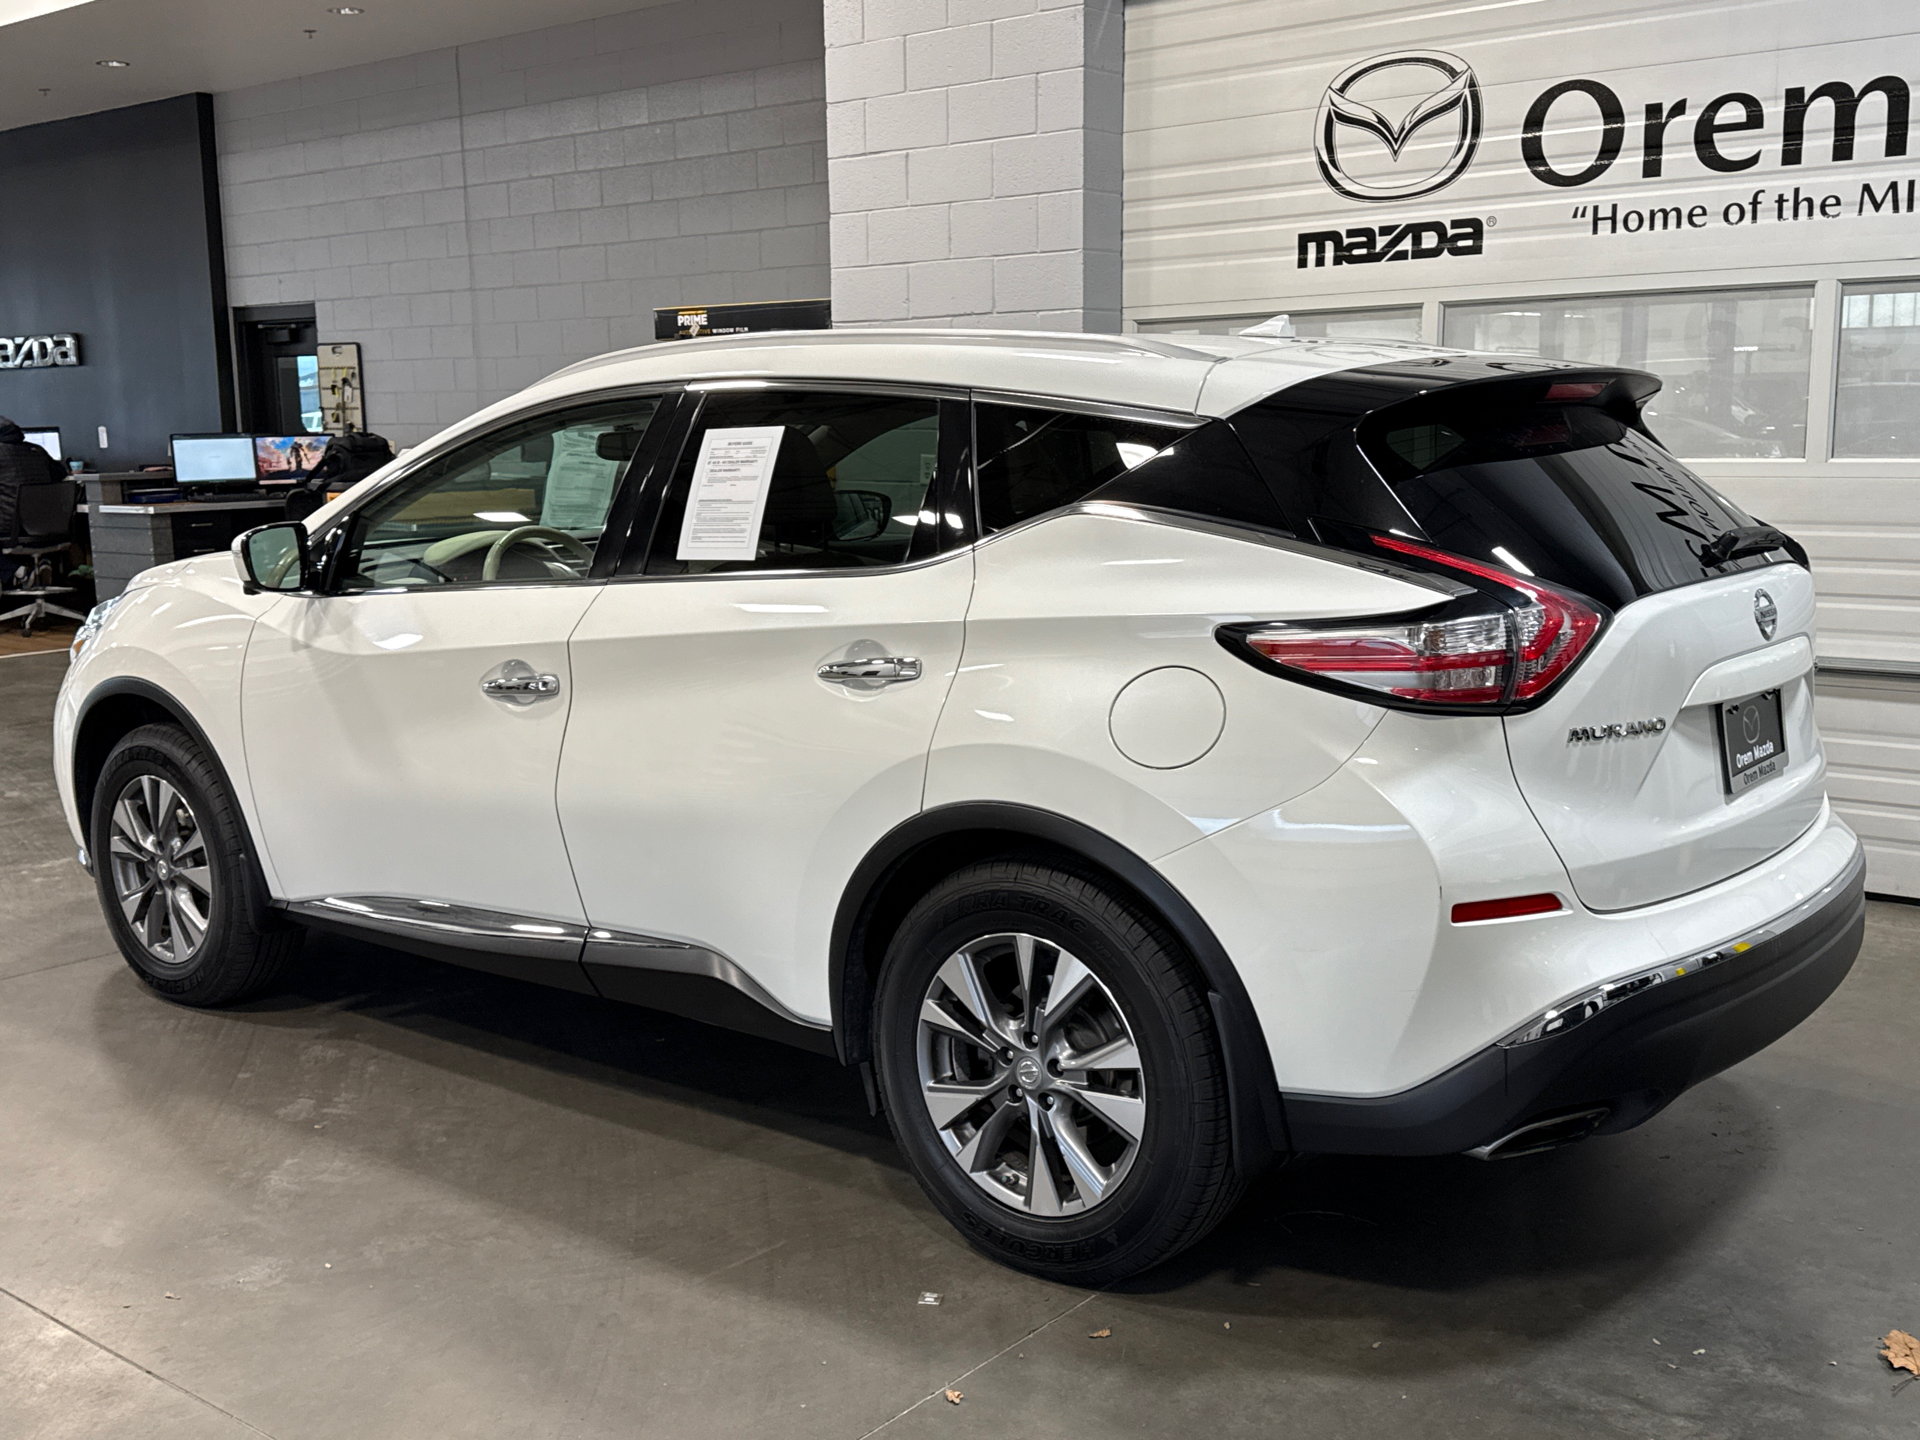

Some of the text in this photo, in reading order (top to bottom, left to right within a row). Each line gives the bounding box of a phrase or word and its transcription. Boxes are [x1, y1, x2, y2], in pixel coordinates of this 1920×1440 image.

[1520, 75, 1911, 188] Orem
[1722, 189, 1766, 226] of
[1774, 186, 1842, 221] the
[1857, 179, 1916, 216] MI
[677, 314, 708, 326] PRIME
[1567, 717, 1667, 744] MURANO
[1736, 739, 1774, 769] Orem Mazda
[1743, 760, 1776, 786] Orem Mazda
[1019, 893, 1088, 935] TRAC
[962, 1211, 1097, 1263] HERCULES
